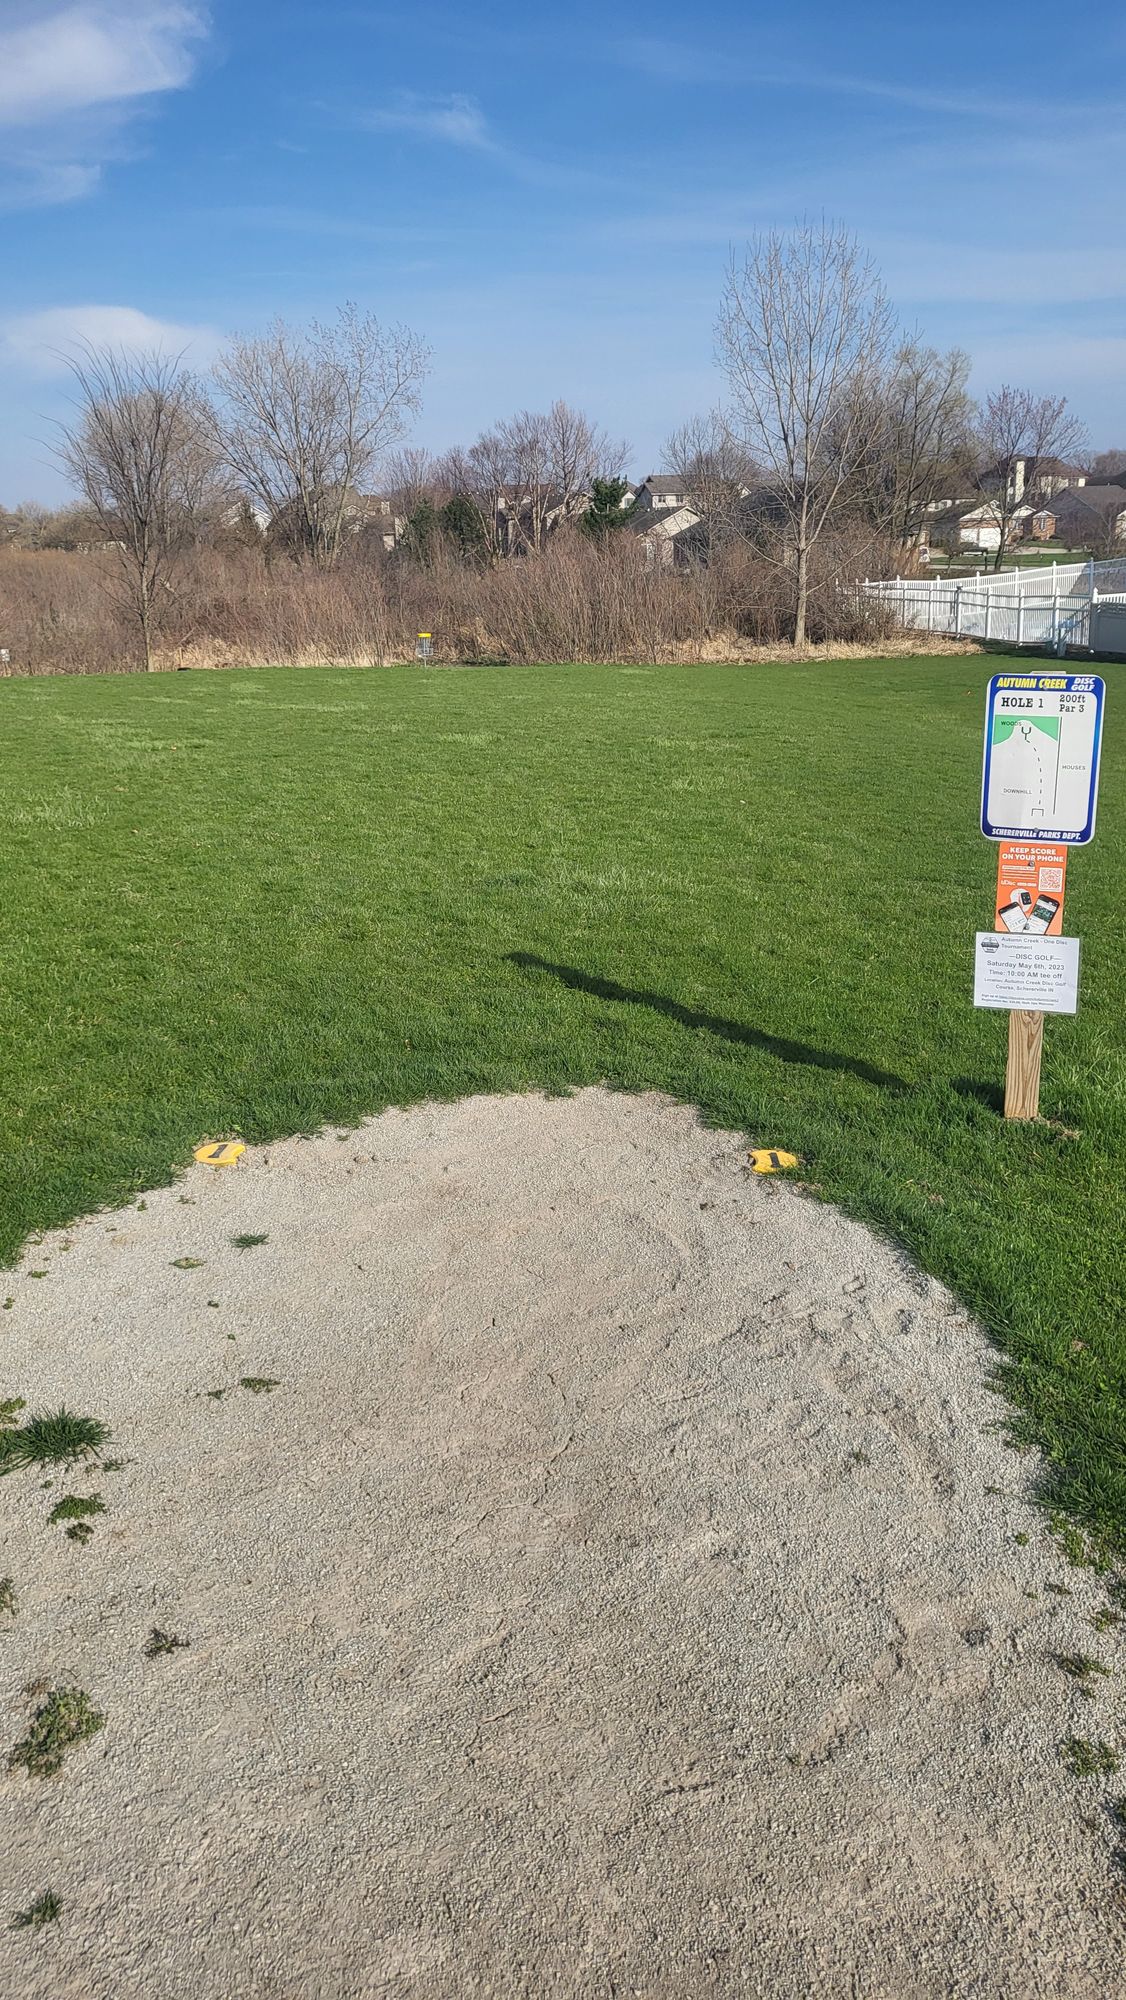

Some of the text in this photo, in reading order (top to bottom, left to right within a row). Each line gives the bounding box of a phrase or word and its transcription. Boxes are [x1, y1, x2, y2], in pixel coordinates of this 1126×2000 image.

[996, 677, 1067, 689] AUTUMN CREEK
[1001, 697, 1044, 708] HOLE 1
[1060, 694, 1086, 703] 200ft
[1059, 704, 1084, 712] Par 3
[1038, 831, 1061, 839] PARKS
[986, 960, 1016, 968] Saturday
[208, 1144, 228, 1158] 1
[768, 1152, 783, 1168] 1
